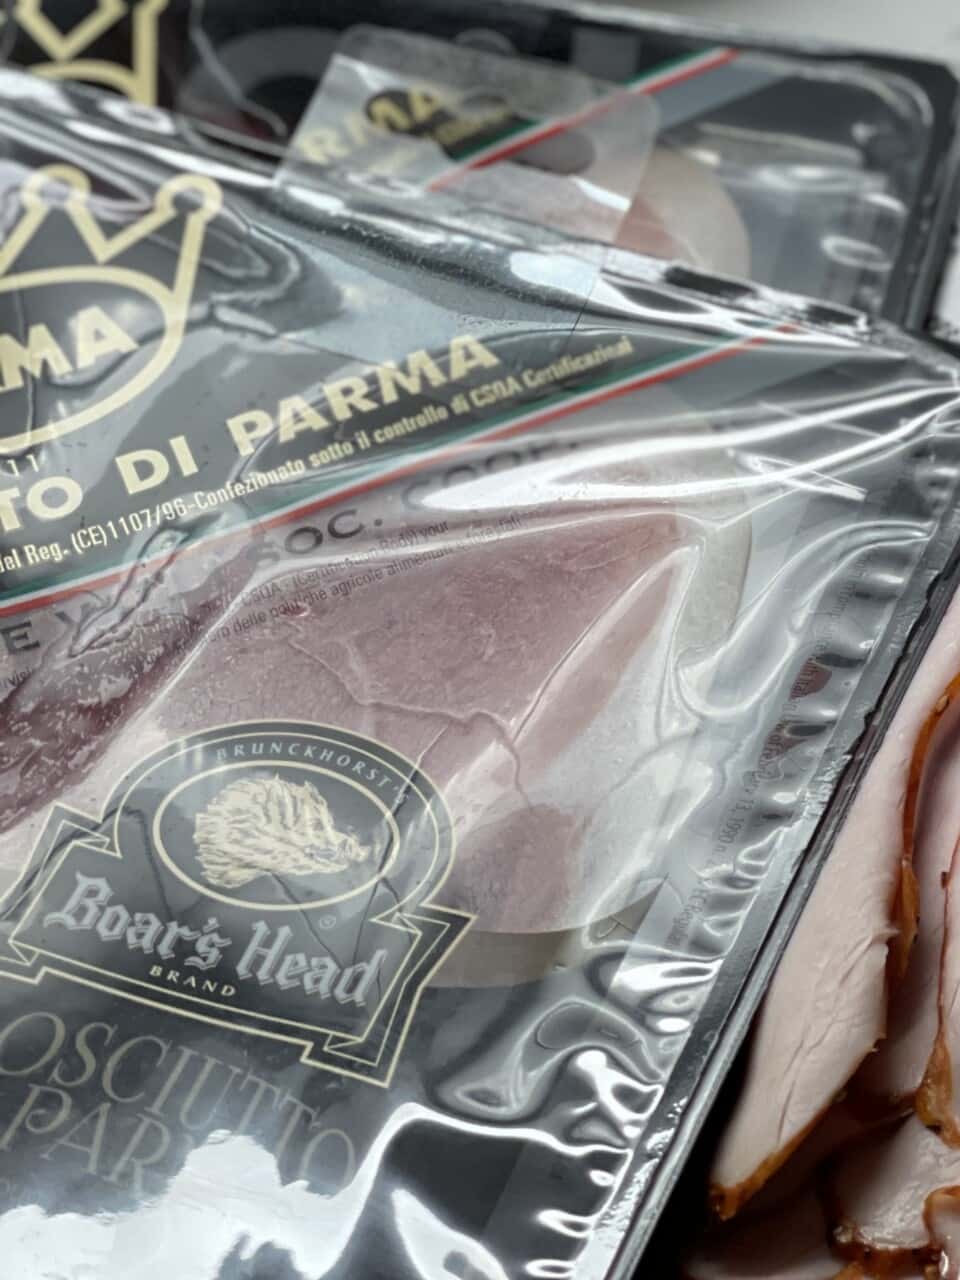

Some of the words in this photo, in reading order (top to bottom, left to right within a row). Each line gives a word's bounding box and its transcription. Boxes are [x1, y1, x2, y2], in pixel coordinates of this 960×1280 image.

[24, 540, 70, 563] Reg.
[308, 439, 354, 468] sotto
[354, 430, 371, 451] il
[373, 403, 450, 447] controllo
[115, 435, 199, 495] DI
[226, 333, 500, 457] PARMA
[331, 561, 384, 597] agricole
[43, 862, 232, 970] Boar's
[236, 920, 388, 1008] Head
[149, 964, 237, 998] BRAND
